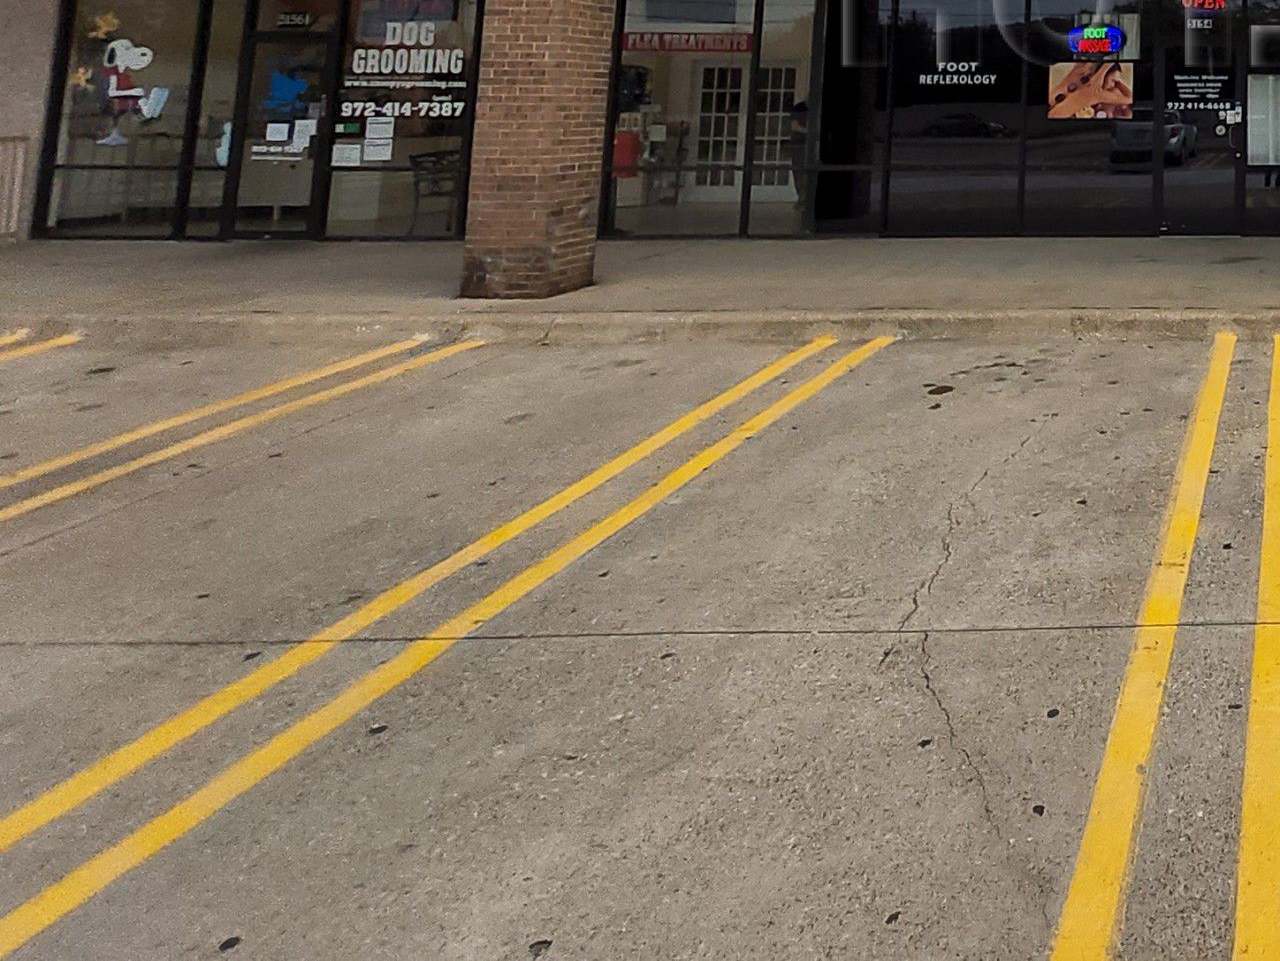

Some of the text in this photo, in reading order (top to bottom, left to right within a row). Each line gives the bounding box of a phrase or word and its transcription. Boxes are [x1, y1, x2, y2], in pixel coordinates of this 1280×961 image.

[384, 21, 436, 47] DOG
[1083, 27, 1107, 39] FOOT
[627, 33, 749, 51] FLEA TREATMENTS
[351, 48, 464, 74] GROOMING
[937, 61, 979, 72] FOOT
[919, 74, 997, 85] REFLEXOLOGY
[340, 101, 465, 117] 972-414-7387
[1167, 101, 1185, 110] 972
